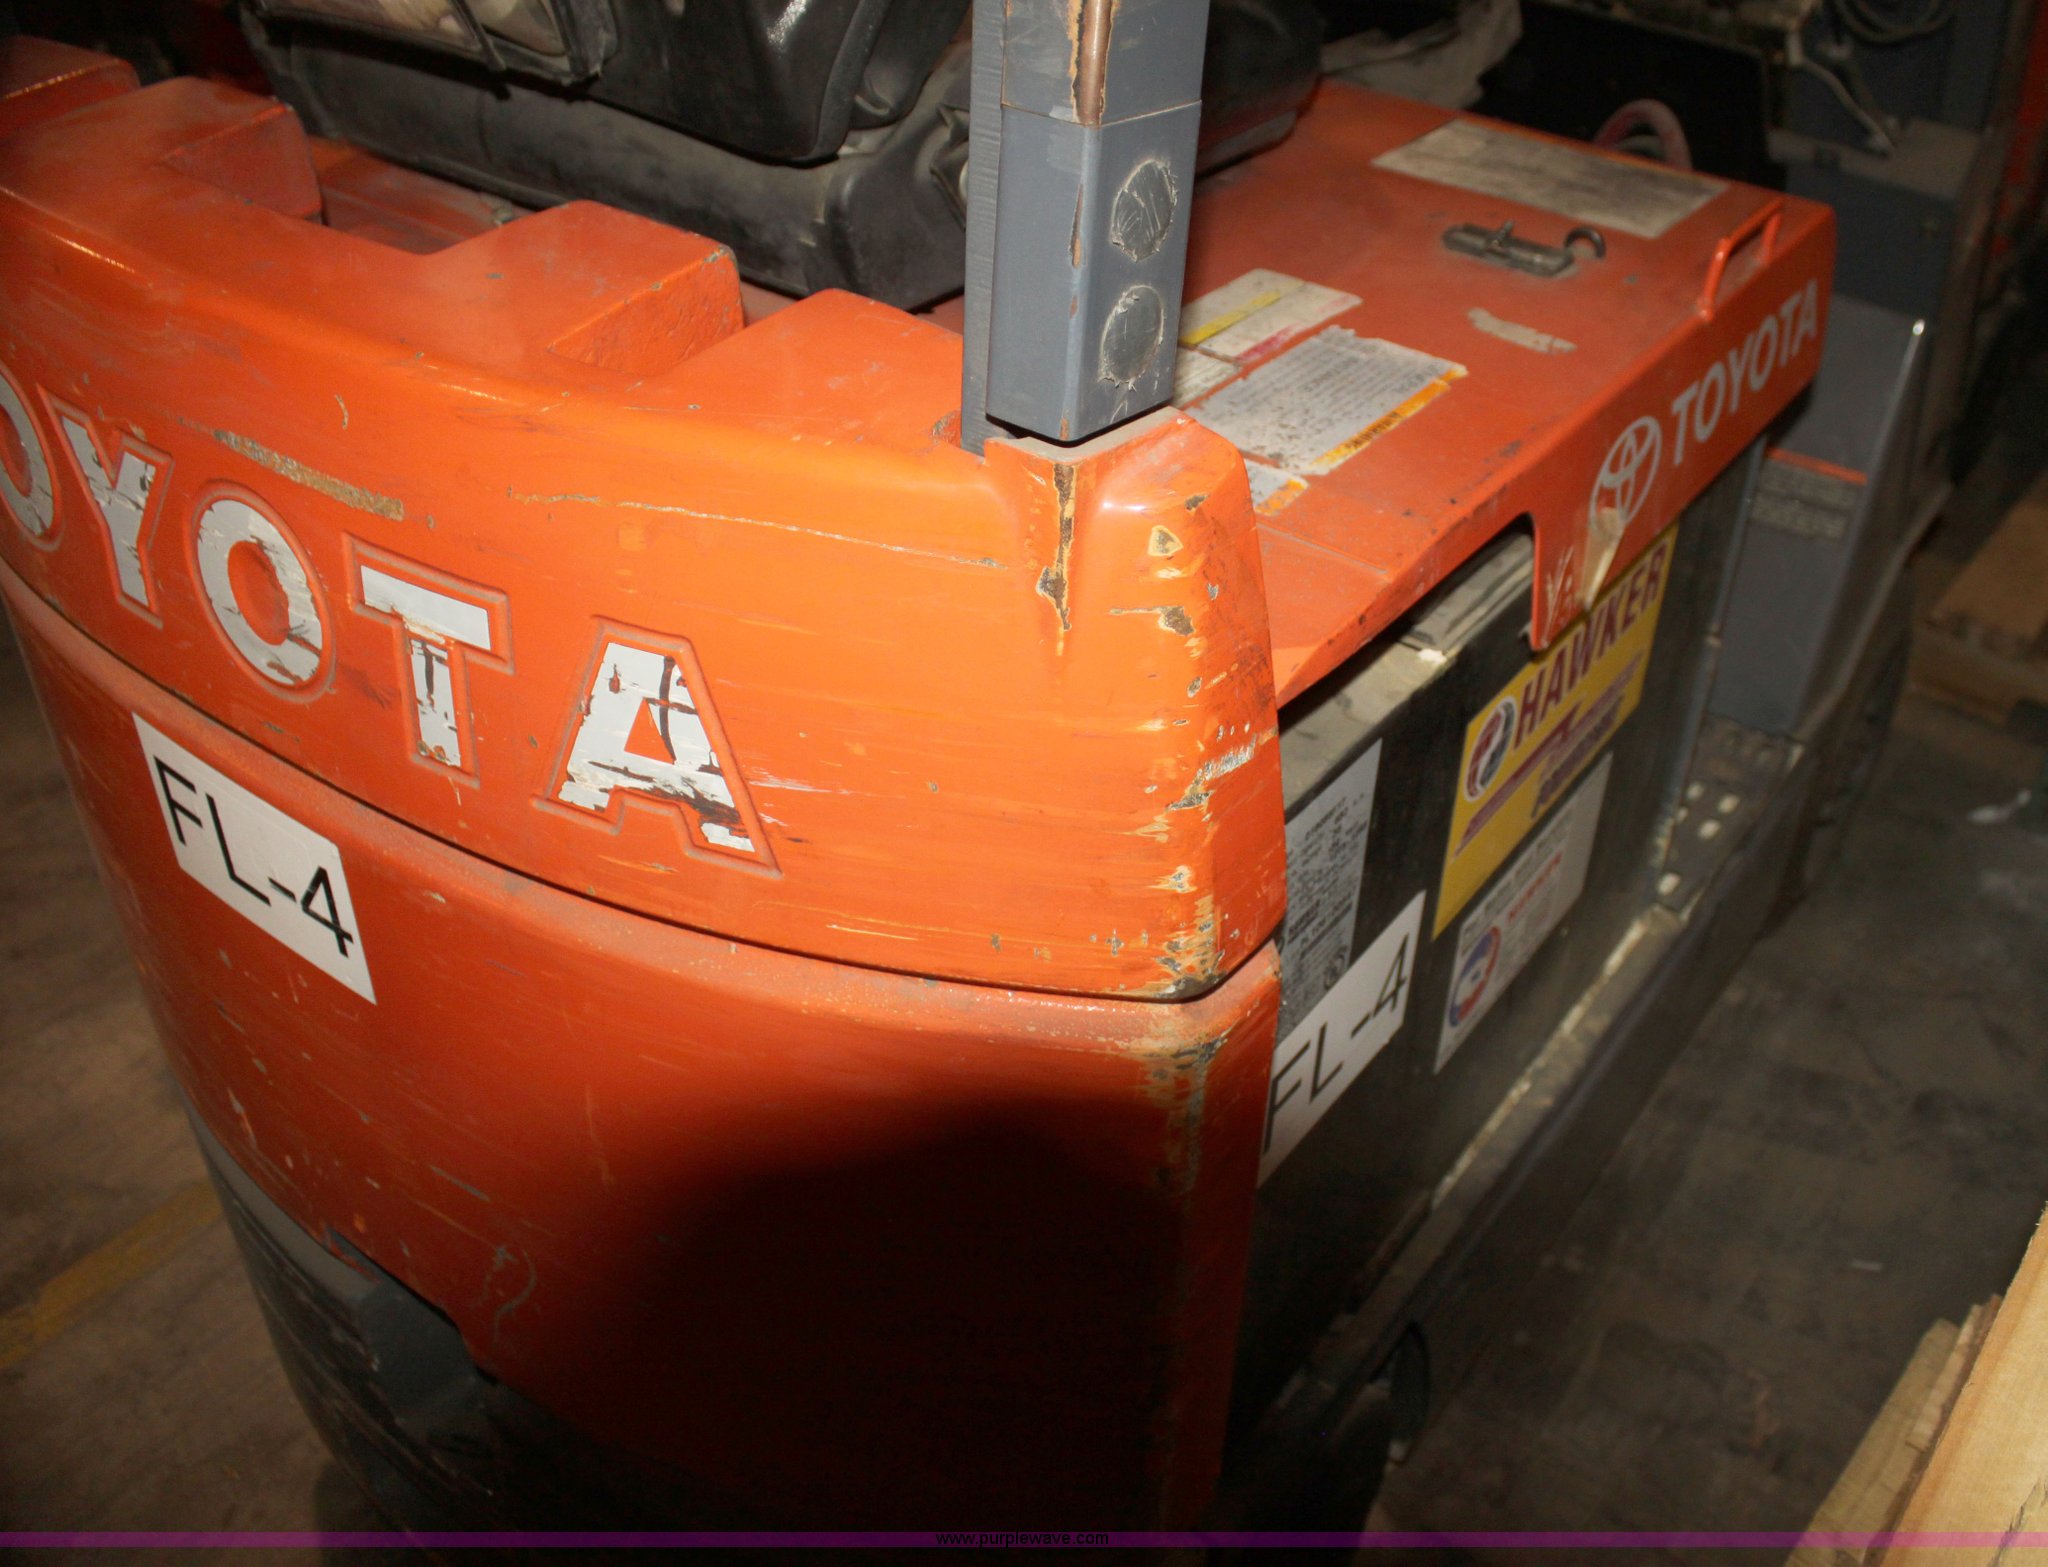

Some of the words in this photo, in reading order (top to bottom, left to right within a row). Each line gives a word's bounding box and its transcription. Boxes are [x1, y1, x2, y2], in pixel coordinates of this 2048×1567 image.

[1671, 278, 1818, 467] TOYOTA
[1513, 541, 1669, 751] HAWKER
[152, 754, 354, 959] FL-4
[1263, 932, 1410, 1155] FL-4
